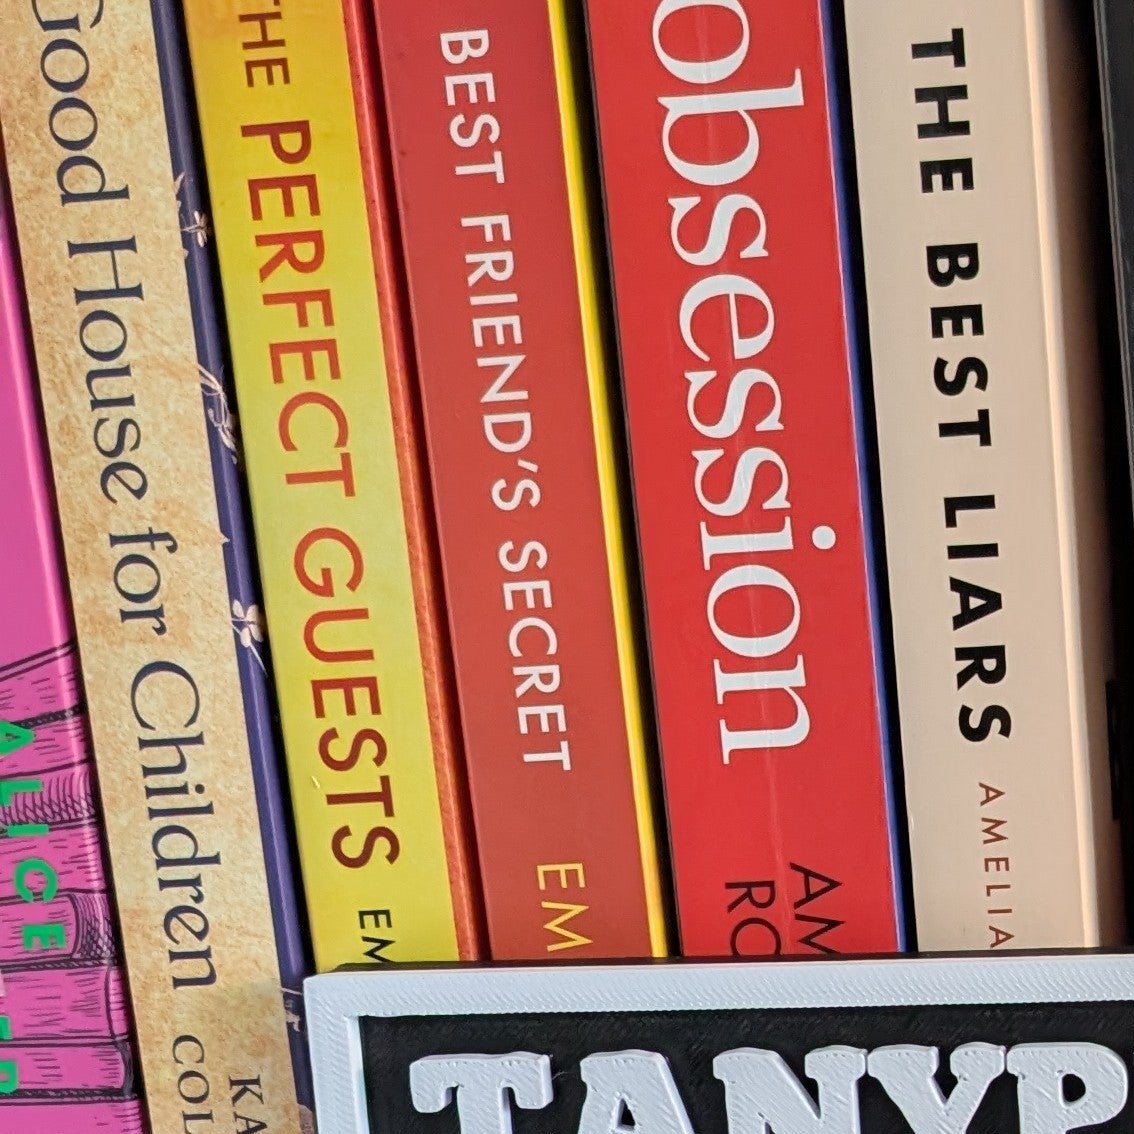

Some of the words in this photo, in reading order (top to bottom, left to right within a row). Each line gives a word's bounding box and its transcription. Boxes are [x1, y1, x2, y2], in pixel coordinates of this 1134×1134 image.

[239, 0, 290, 87] HE
[440, 29, 505, 185] BEST
[911, 28, 974, 193] THE
[67, 235, 148, 504] House
[240, 119, 356, 498] PERFECT
[461, 214, 541, 511] FRIEND'S
[652, 0, 836, 765] obsession
[925, 243, 992, 447] BEST
[109, 527, 178, 636] for
[499, 541, 572, 772] SECRET
[943, 495, 1012, 742] LIARS
[293, 527, 400, 869] GUESTS
[0, 720, 66, 950] ALICE
[130, 660, 221, 990] Children
[536, 863, 594, 952] EM
[978, 782, 1015, 949] AMELIA
